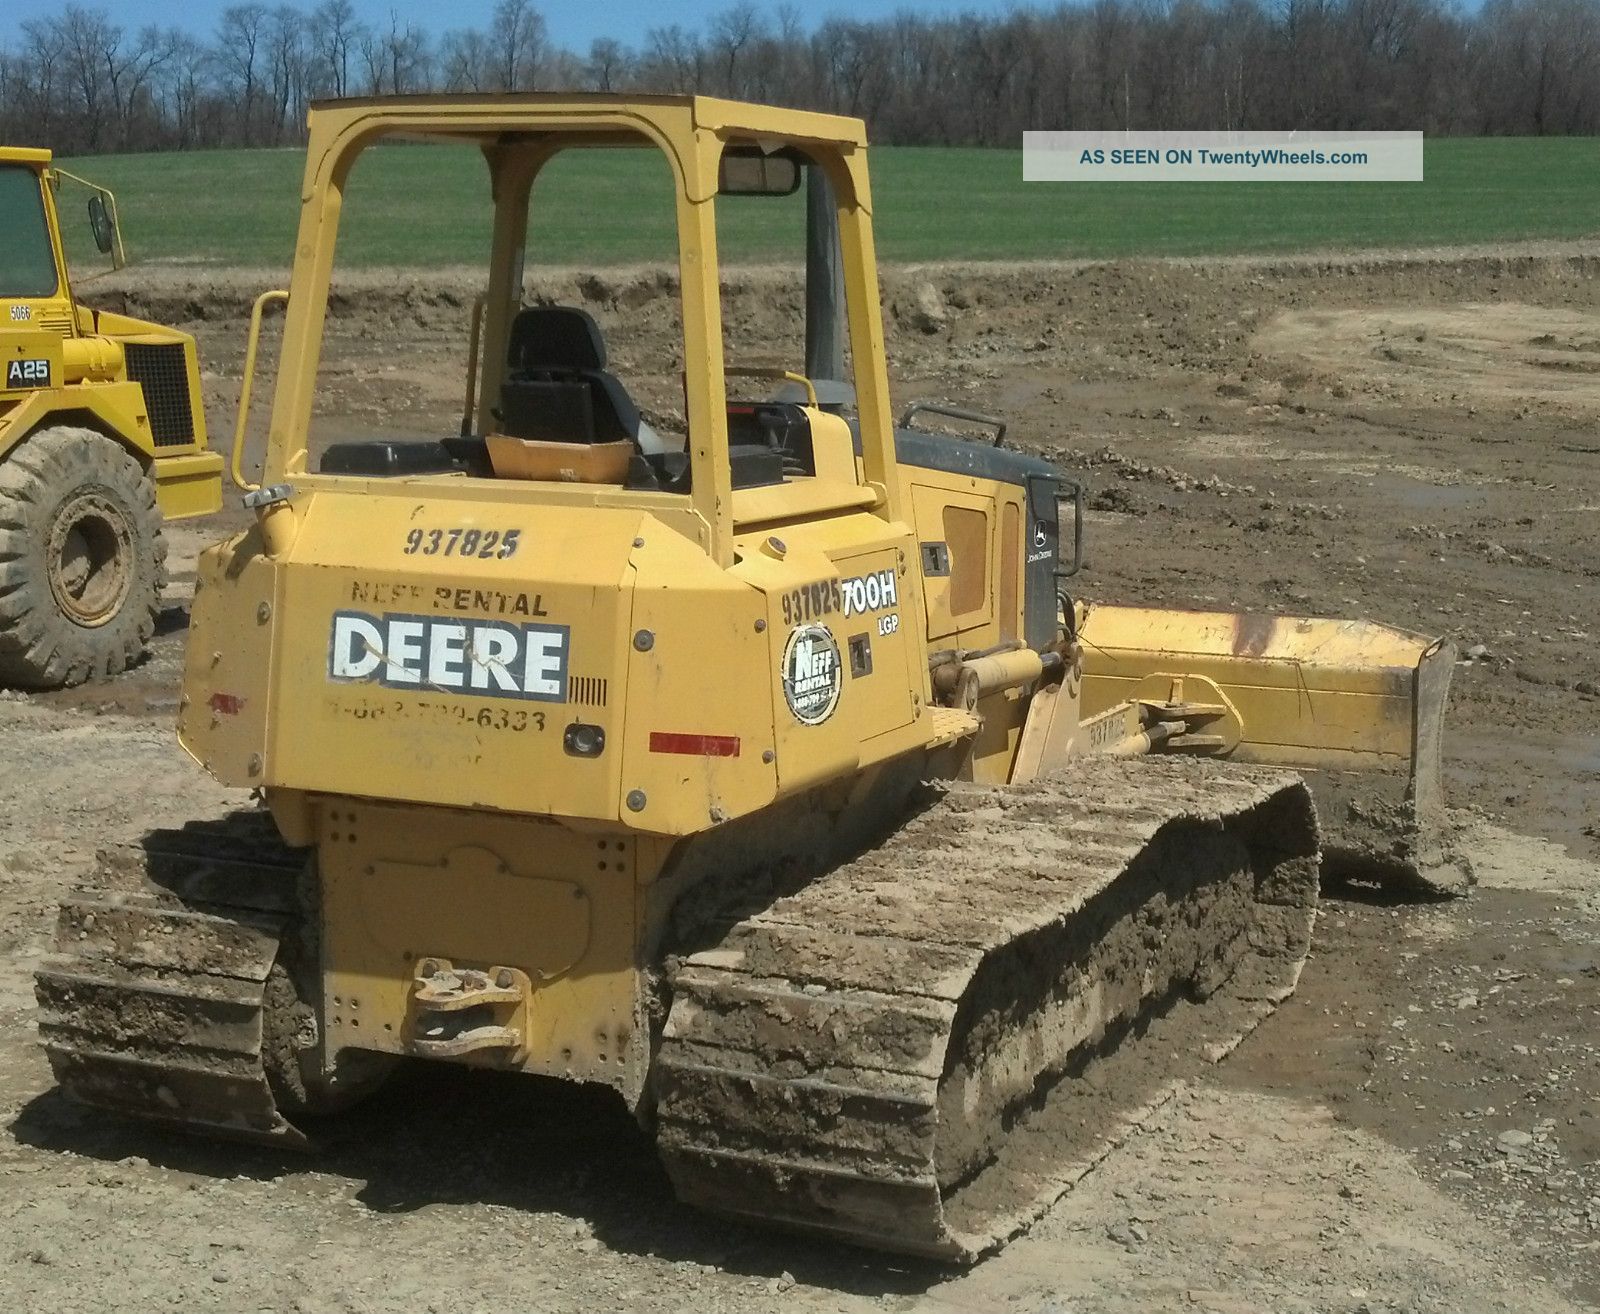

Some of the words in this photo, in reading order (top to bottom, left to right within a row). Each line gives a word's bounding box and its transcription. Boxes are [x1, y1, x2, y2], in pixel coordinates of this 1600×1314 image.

[10, 306, 31, 320] 5066
[9, 360, 48, 379] A25
[403, 529, 520, 560] 937825
[433, 586, 548, 617] RENTAL
[782, 578, 841, 625] 937825
[842, 570, 897, 618] 700H
[877, 613, 899, 637] LGP
[332, 616, 563, 695] DEERE
[794, 673, 832, 694] RENTAL
